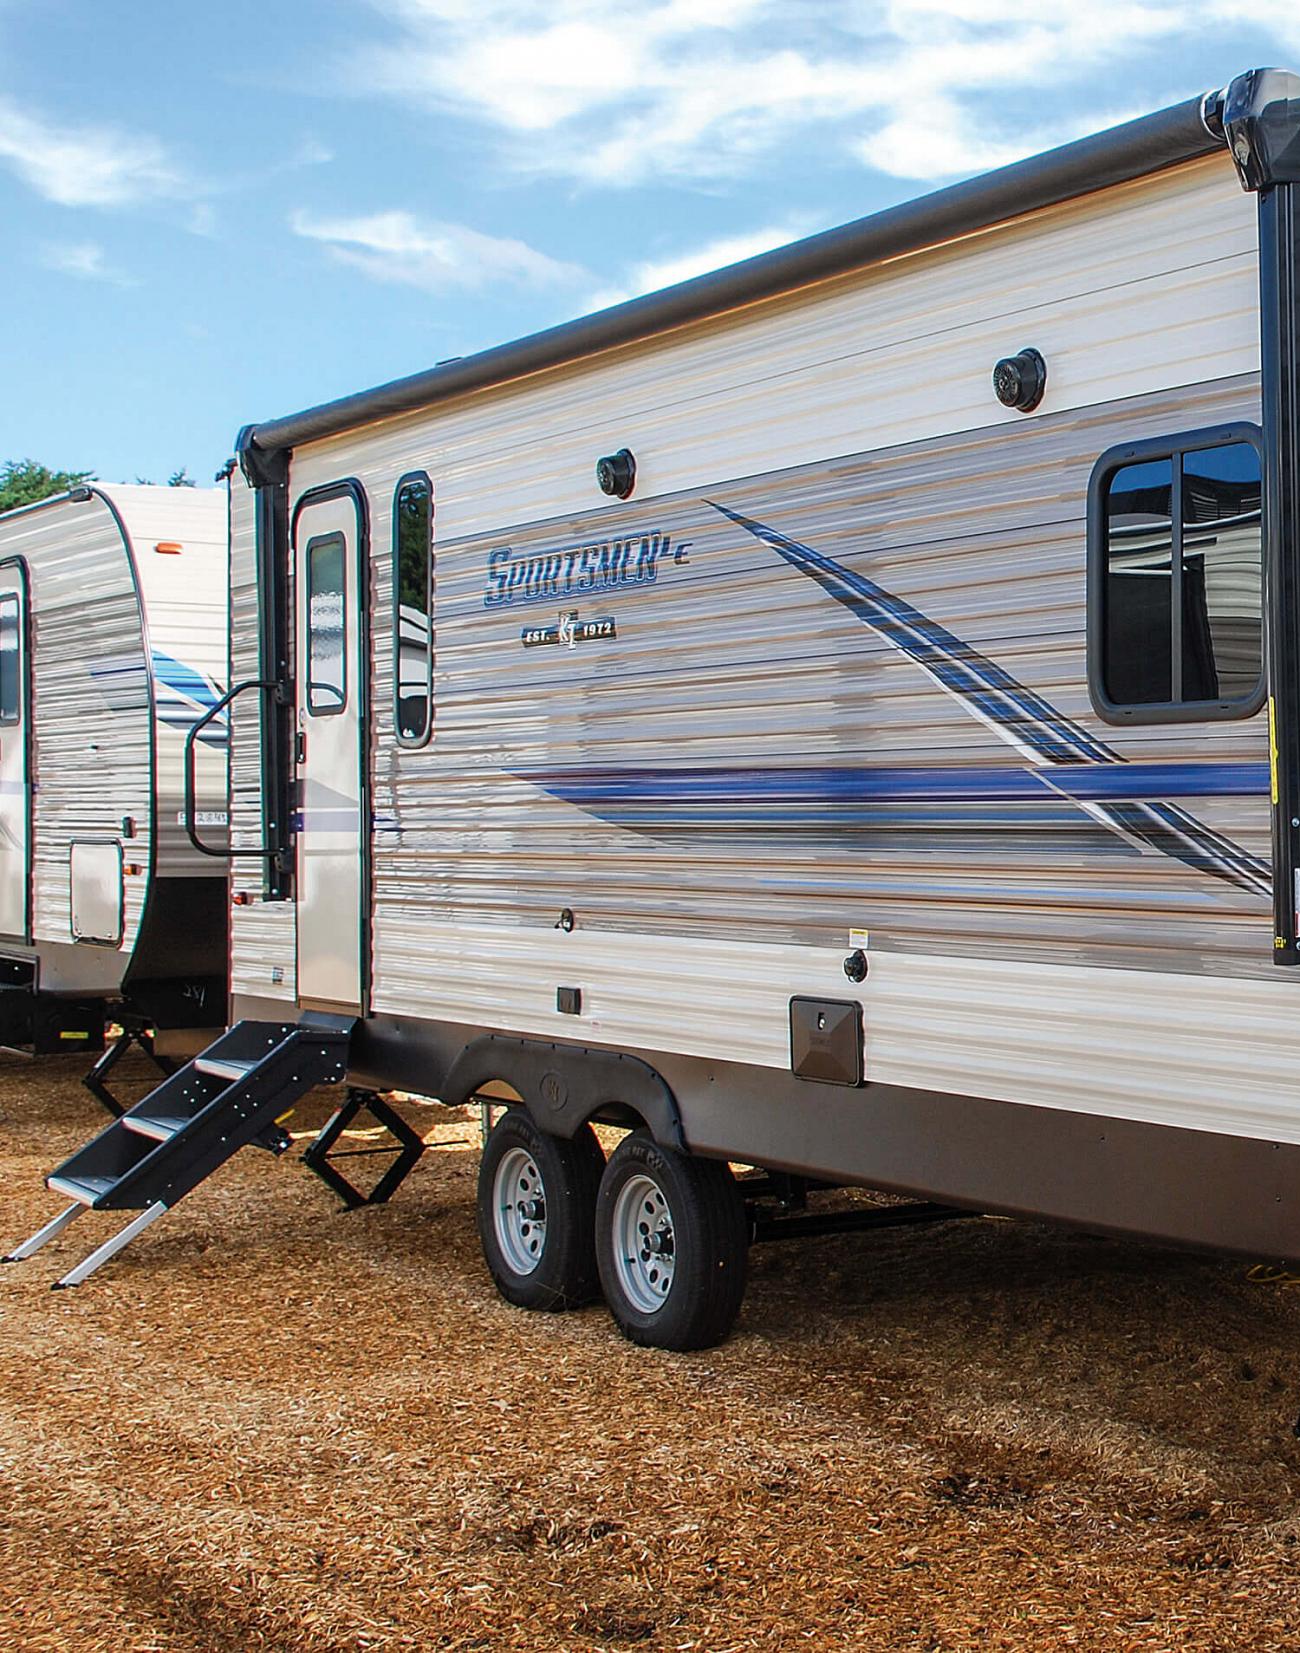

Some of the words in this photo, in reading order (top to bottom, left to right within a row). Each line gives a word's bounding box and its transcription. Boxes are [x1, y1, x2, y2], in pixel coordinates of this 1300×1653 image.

[483, 528, 661, 608] SPORTSMEN
[526, 628, 551, 643] EST.
[583, 621, 613, 637] 1972
